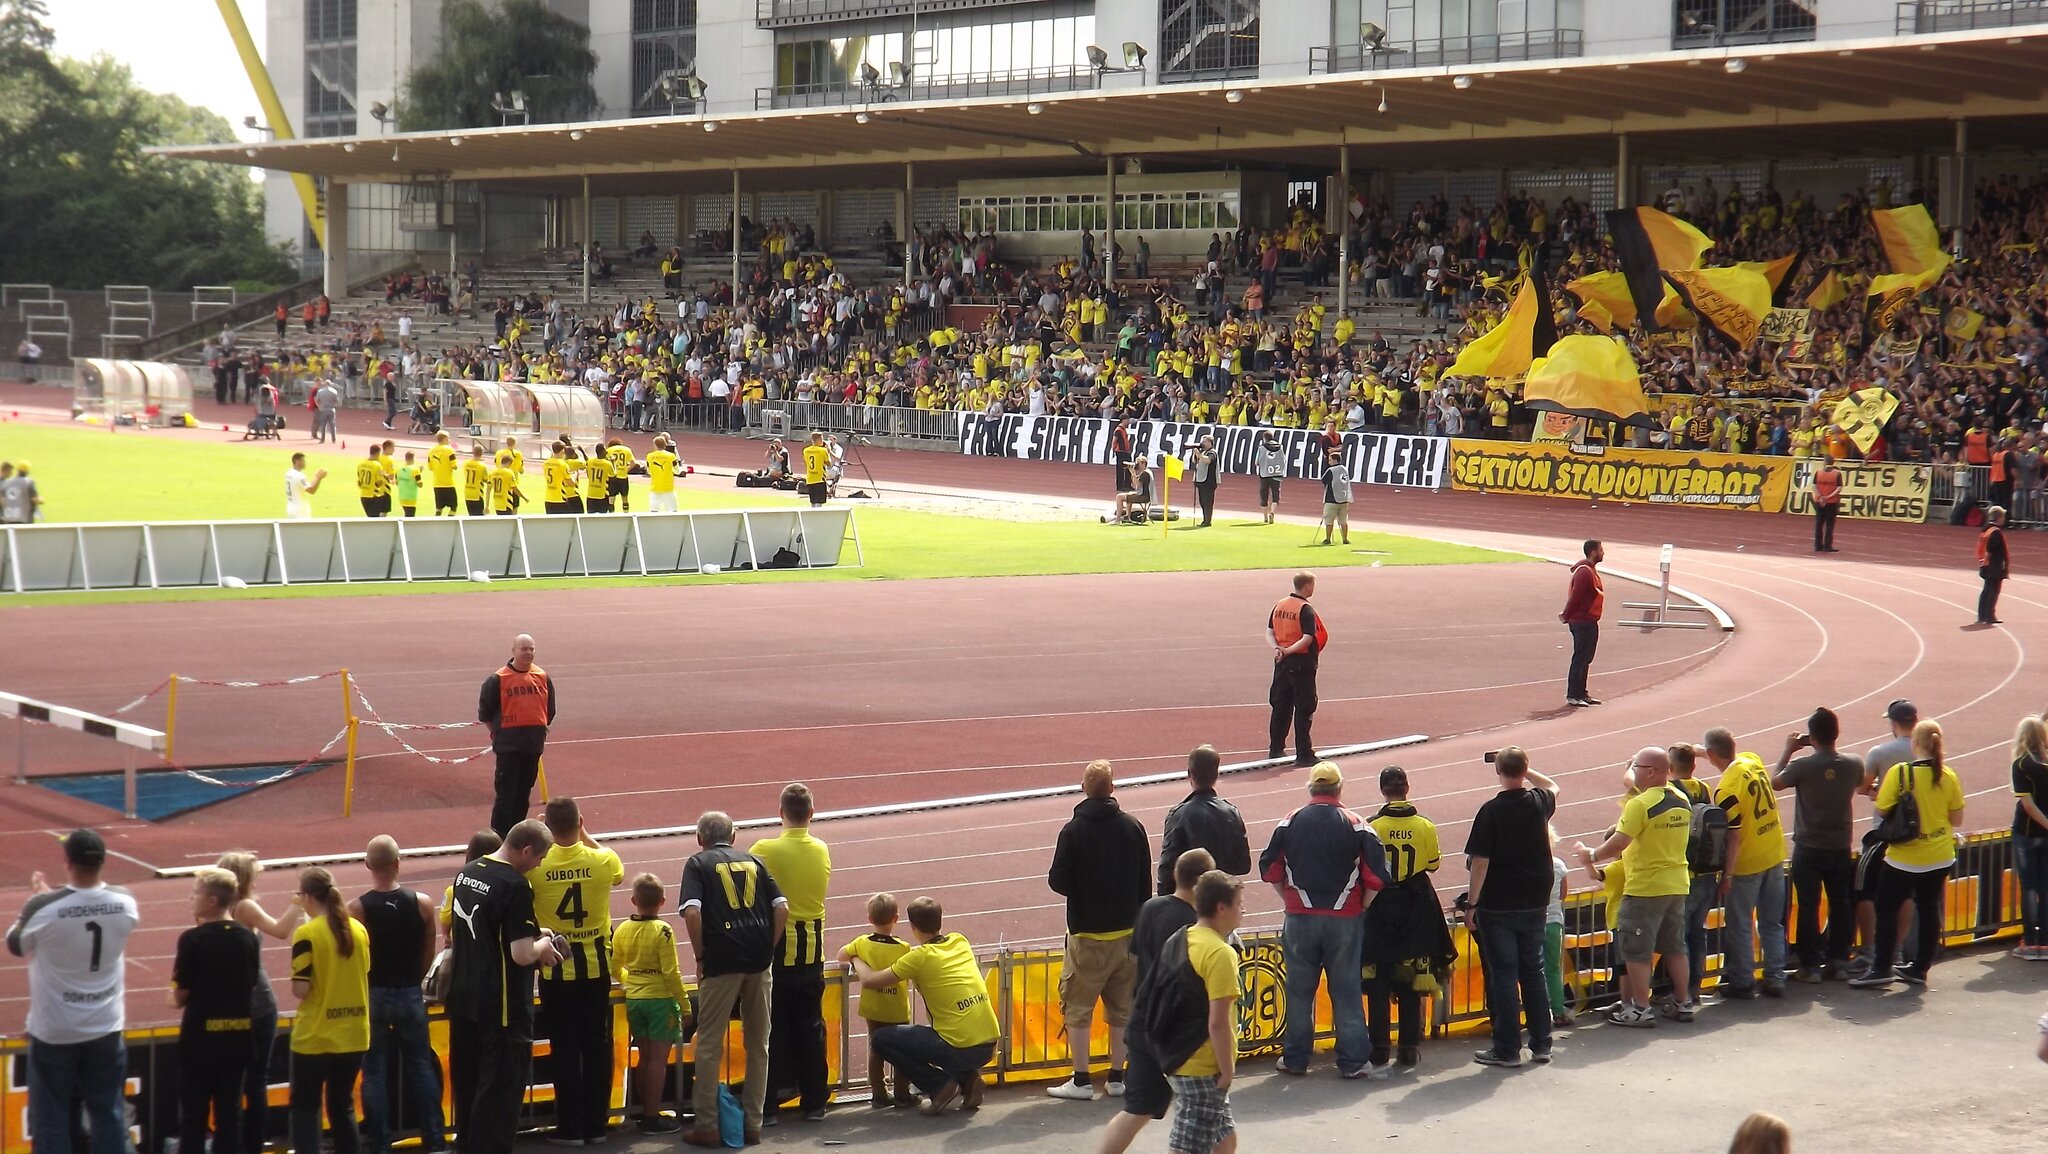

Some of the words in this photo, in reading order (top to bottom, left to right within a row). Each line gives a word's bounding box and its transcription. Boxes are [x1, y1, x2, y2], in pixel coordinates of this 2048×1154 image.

[1028, 416, 1102, 465] SICHT
[809, 455, 815, 470] 3
[1267, 464, 1282, 474] 02
[360, 468, 372, 486] 20
[465, 469, 476, 485] 11
[547, 467, 553, 485] 5
[590, 467, 603, 483] 14
[1454, 455, 1552, 490] SEKTION
[1554, 461, 1761, 498] STADIONVERBOT
[1833, 465, 1897, 489] TETS
[493, 477, 503, 493] 10
[1788, 491, 1925, 519] UNERWEGS
[1389, 830, 1413, 840] REUS
[1385, 843, 1416, 883] 11
[545, 867, 592, 882] SUBOTIC
[716, 861, 758, 910] 17
[57, 902, 125, 919] WEIDENFELLER
[554, 882, 588, 929] 4
[84, 920, 102, 972] 1
